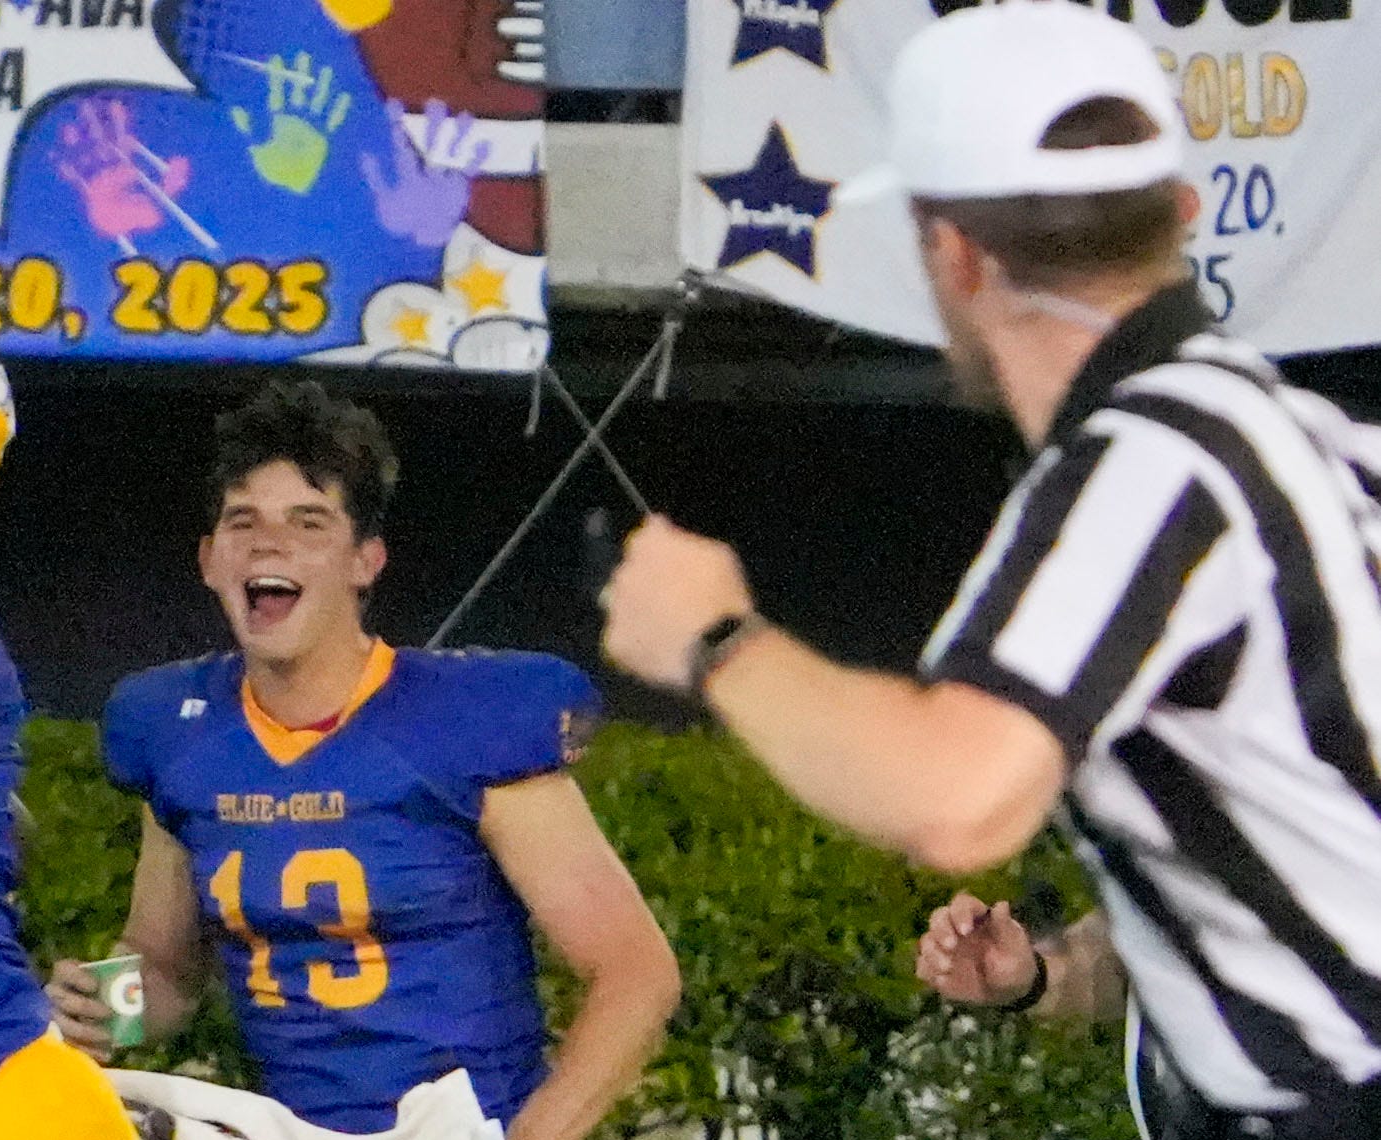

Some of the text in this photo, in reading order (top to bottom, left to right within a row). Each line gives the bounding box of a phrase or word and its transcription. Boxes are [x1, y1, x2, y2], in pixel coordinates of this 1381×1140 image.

[1153, 50, 1307, 141] OLD
[113, 259, 327, 335] 2025
[217, 794, 274, 823] BLUE
[209, 847, 389, 1010] 13
